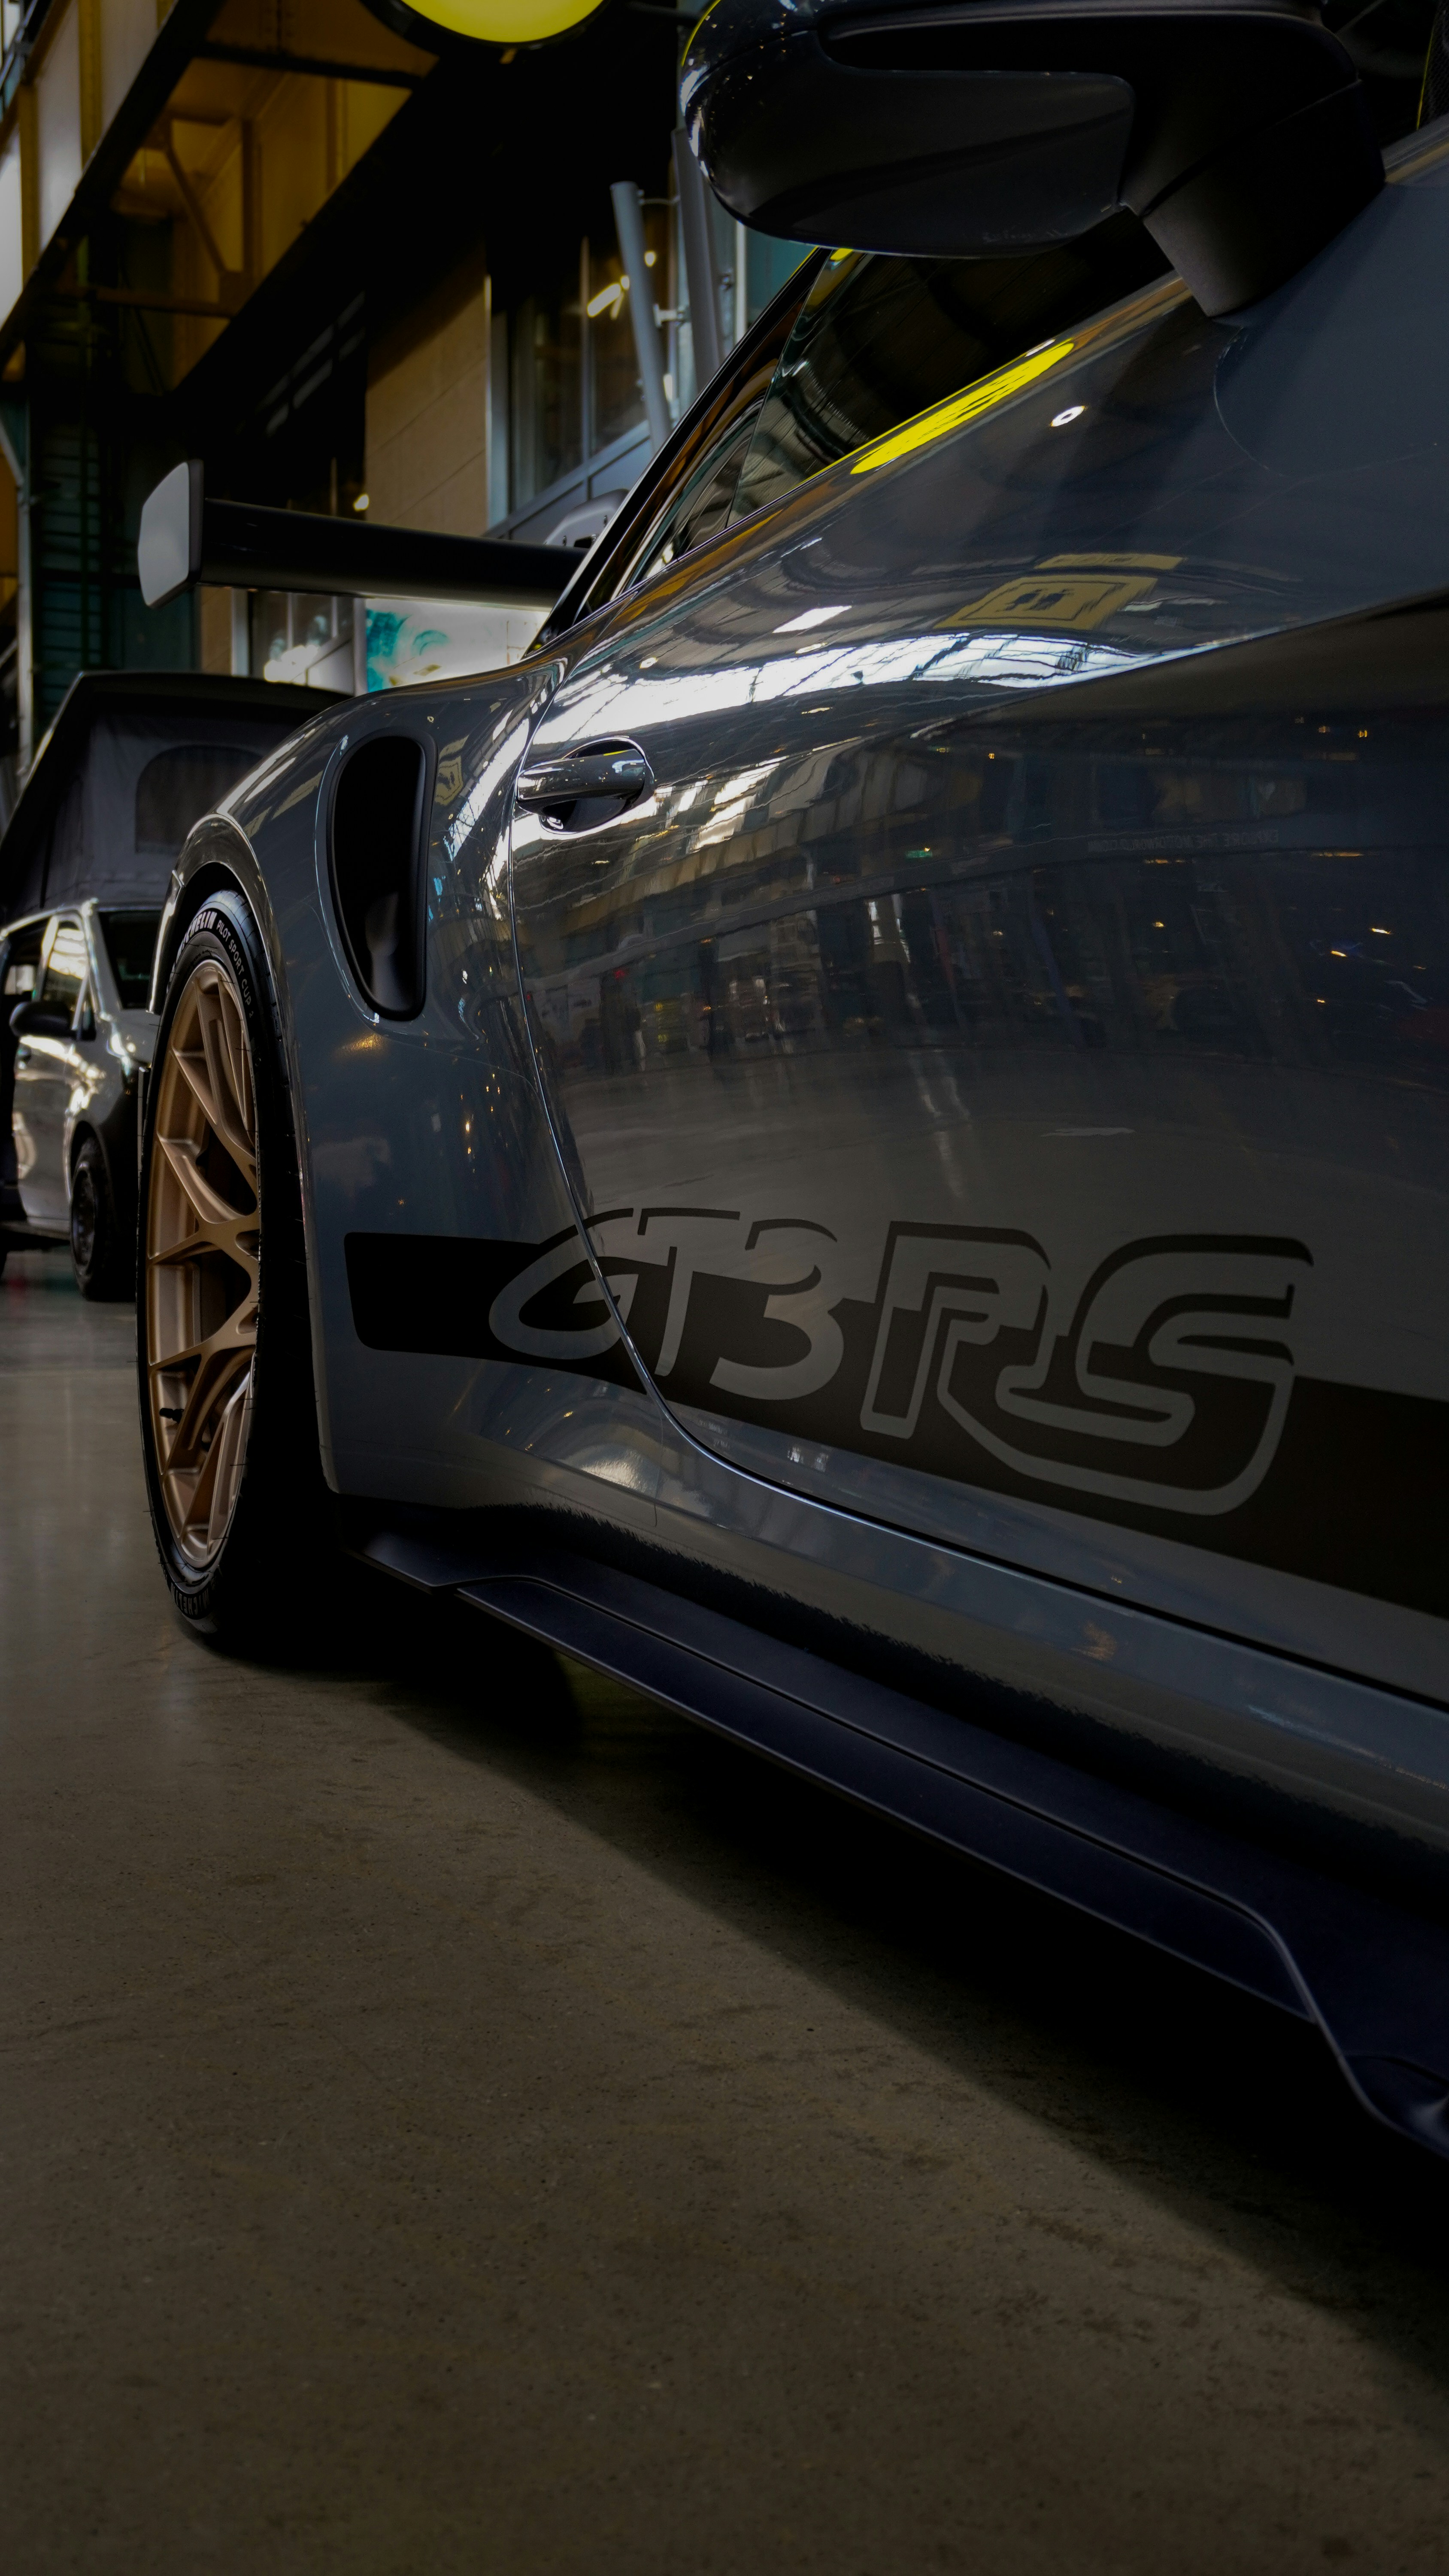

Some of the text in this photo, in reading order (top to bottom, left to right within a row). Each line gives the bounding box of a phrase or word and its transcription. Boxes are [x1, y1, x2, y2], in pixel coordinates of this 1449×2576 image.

[216, 920, 231, 942] PILOT
[229, 939, 244, 975] SPORT
[242, 979, 251, 1005] CUP
